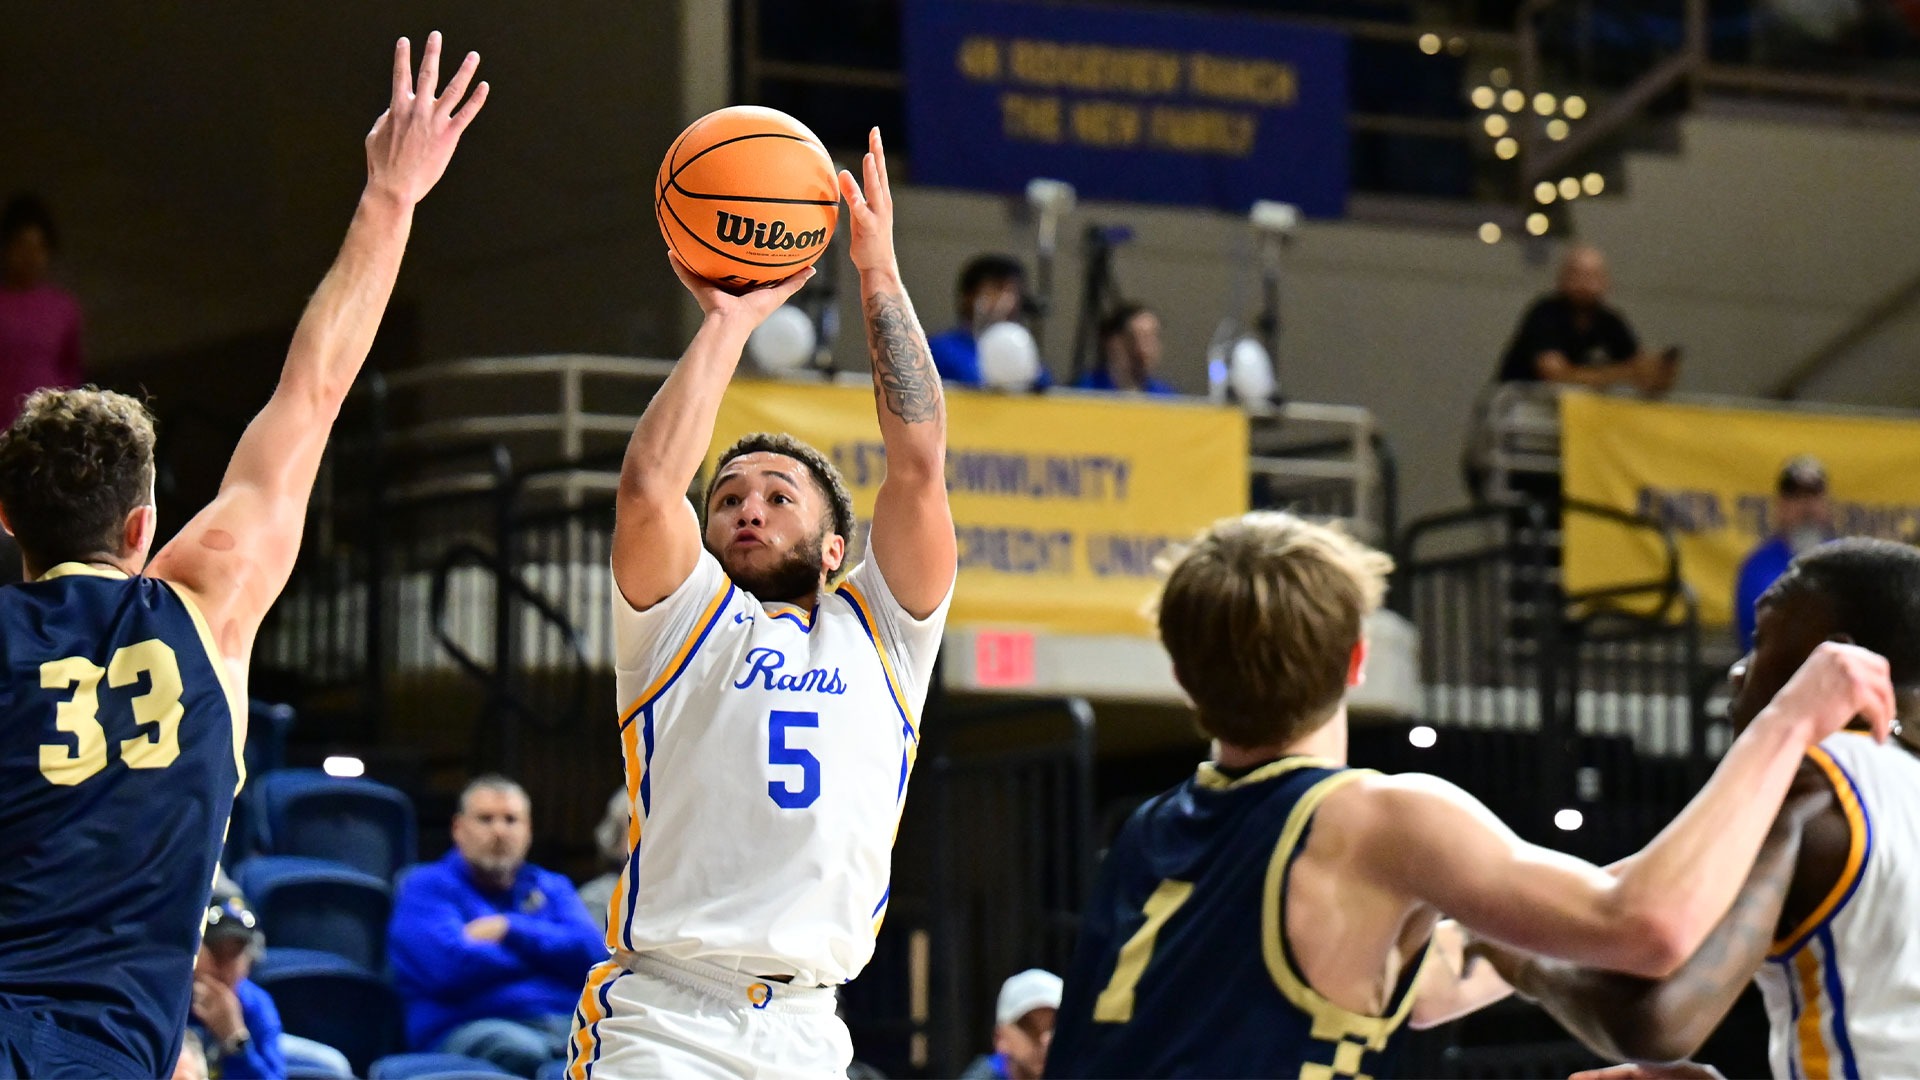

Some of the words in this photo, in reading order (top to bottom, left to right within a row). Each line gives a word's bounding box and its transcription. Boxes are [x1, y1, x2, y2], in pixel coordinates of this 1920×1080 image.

[1001, 94, 1062, 142] THE
[716, 210, 827, 250] Wilson
[734, 647, 847, 695] Rams
[39, 638, 185, 786] 33
[768, 710, 821, 809] 5
[1093, 878, 1195, 1023] 1
